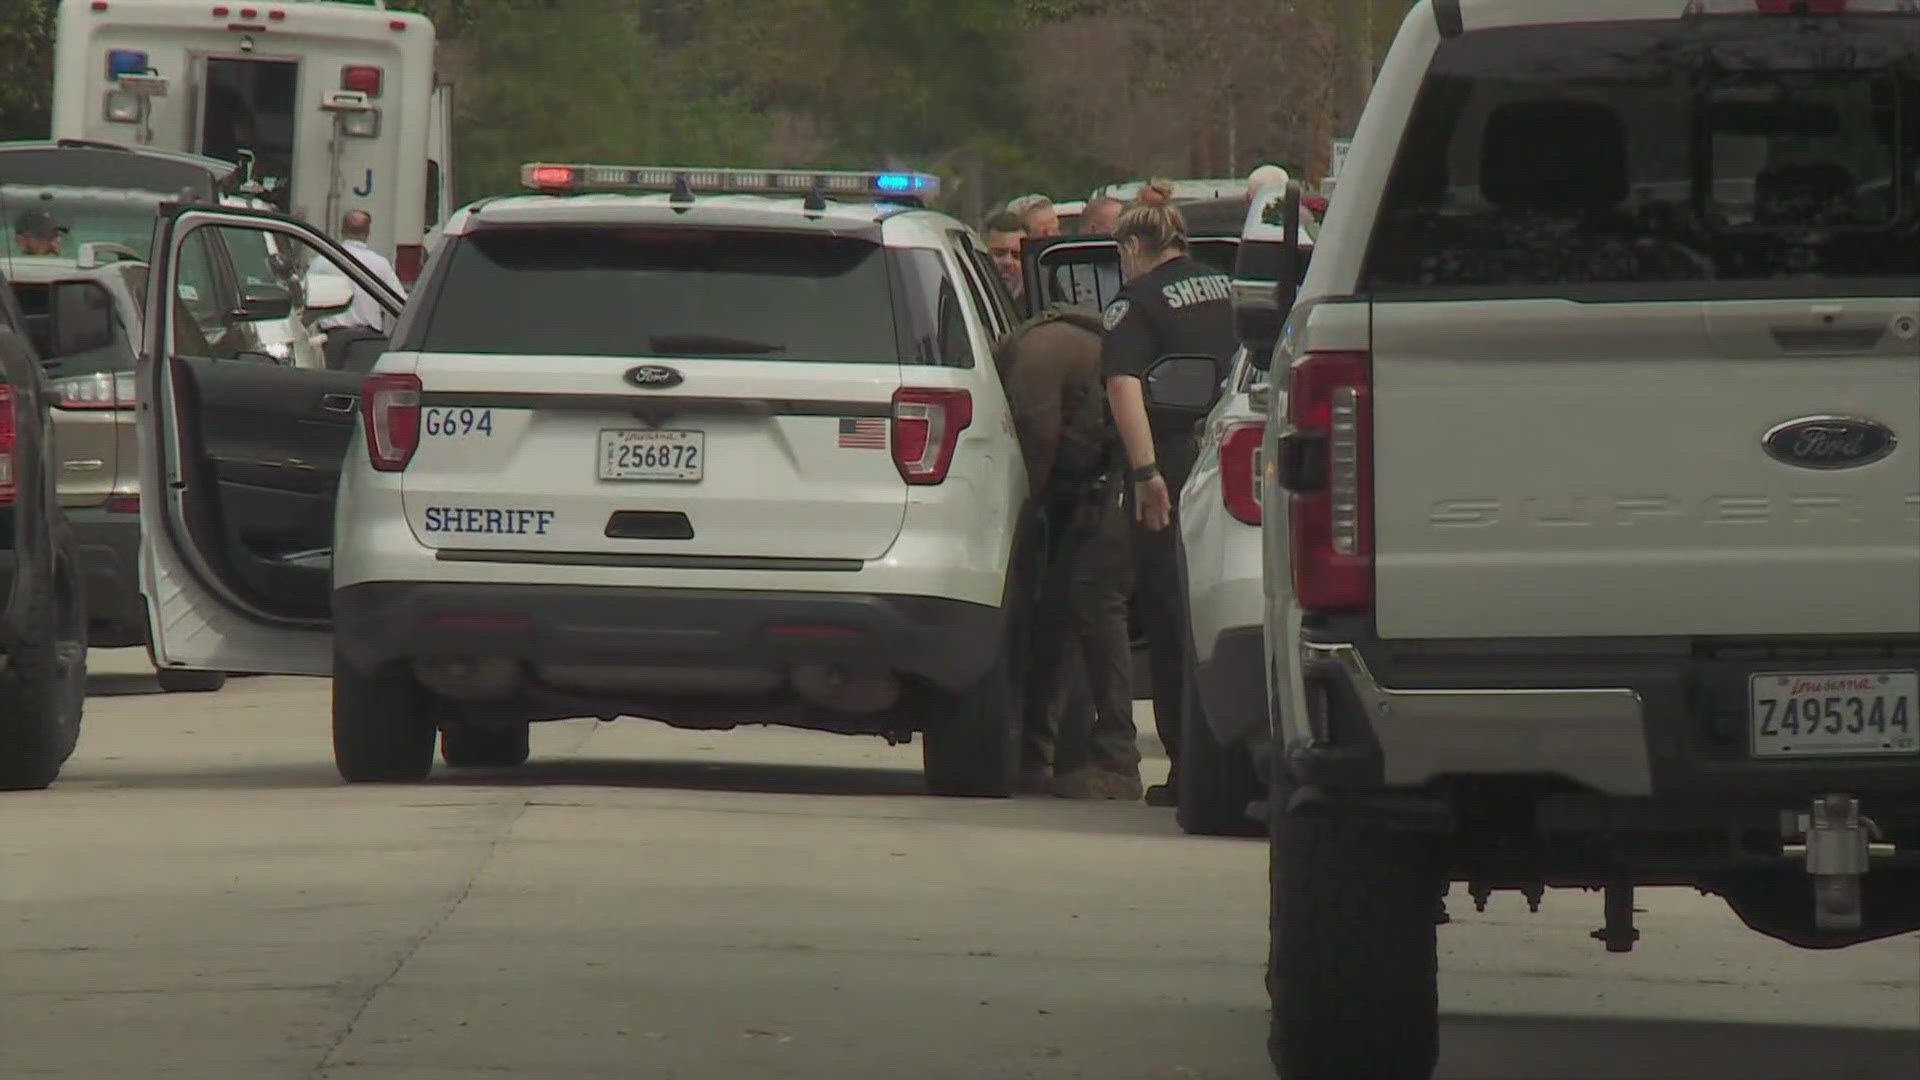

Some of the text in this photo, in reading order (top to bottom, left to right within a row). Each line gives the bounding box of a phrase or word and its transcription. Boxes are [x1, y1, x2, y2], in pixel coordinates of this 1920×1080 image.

[353, 168, 372, 197] J
[636, 367, 671, 382] Ford
[426, 408, 493, 437] G694
[1794, 426, 1866, 457] Ford
[617, 445, 698, 469] 256872
[424, 506, 555, 534] SHERIFF
[1430, 494, 1862, 528] SUPER
[1758, 695, 1908, 736] Z495344
